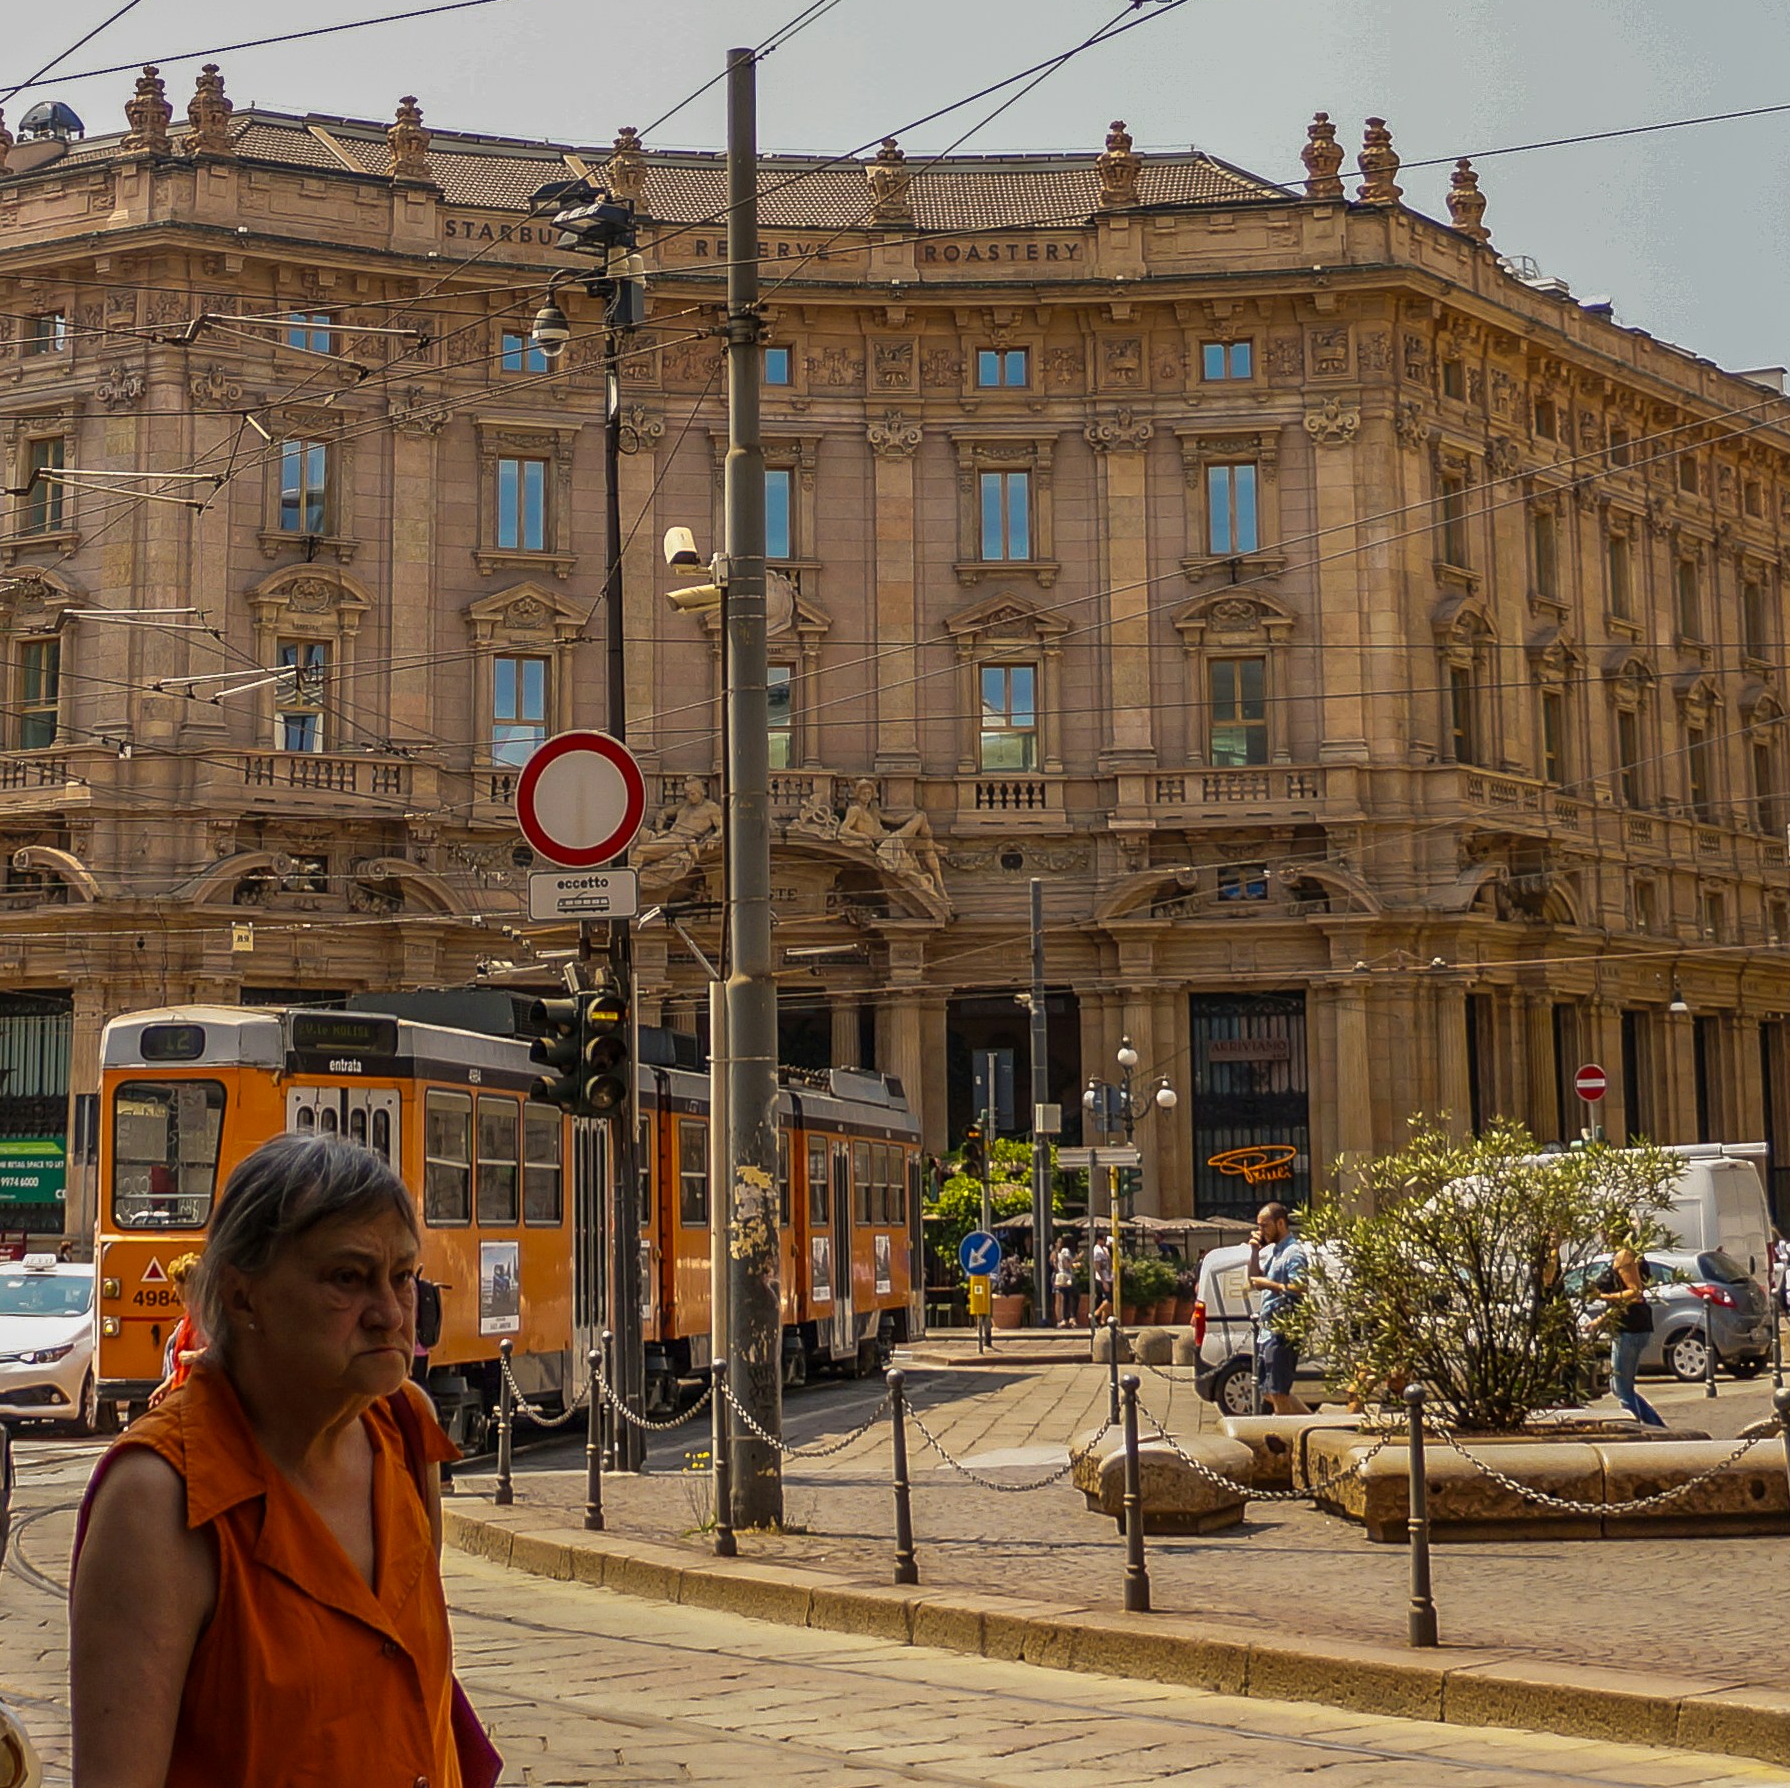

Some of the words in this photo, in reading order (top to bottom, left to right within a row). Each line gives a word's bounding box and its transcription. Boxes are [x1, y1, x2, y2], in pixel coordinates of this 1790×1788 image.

[445, 218, 555, 246] STARBU
[695, 239, 830, 260] REERVE
[925, 242, 1080, 261] ROASTERY
[557, 876, 609, 889] eccetto
[162, 1032, 190, 1052] 12
[329, 1059, 362, 1073] entrata
[0, 1177, 19, 1187] 9974
[133, 1290, 181, 1307] 4984
